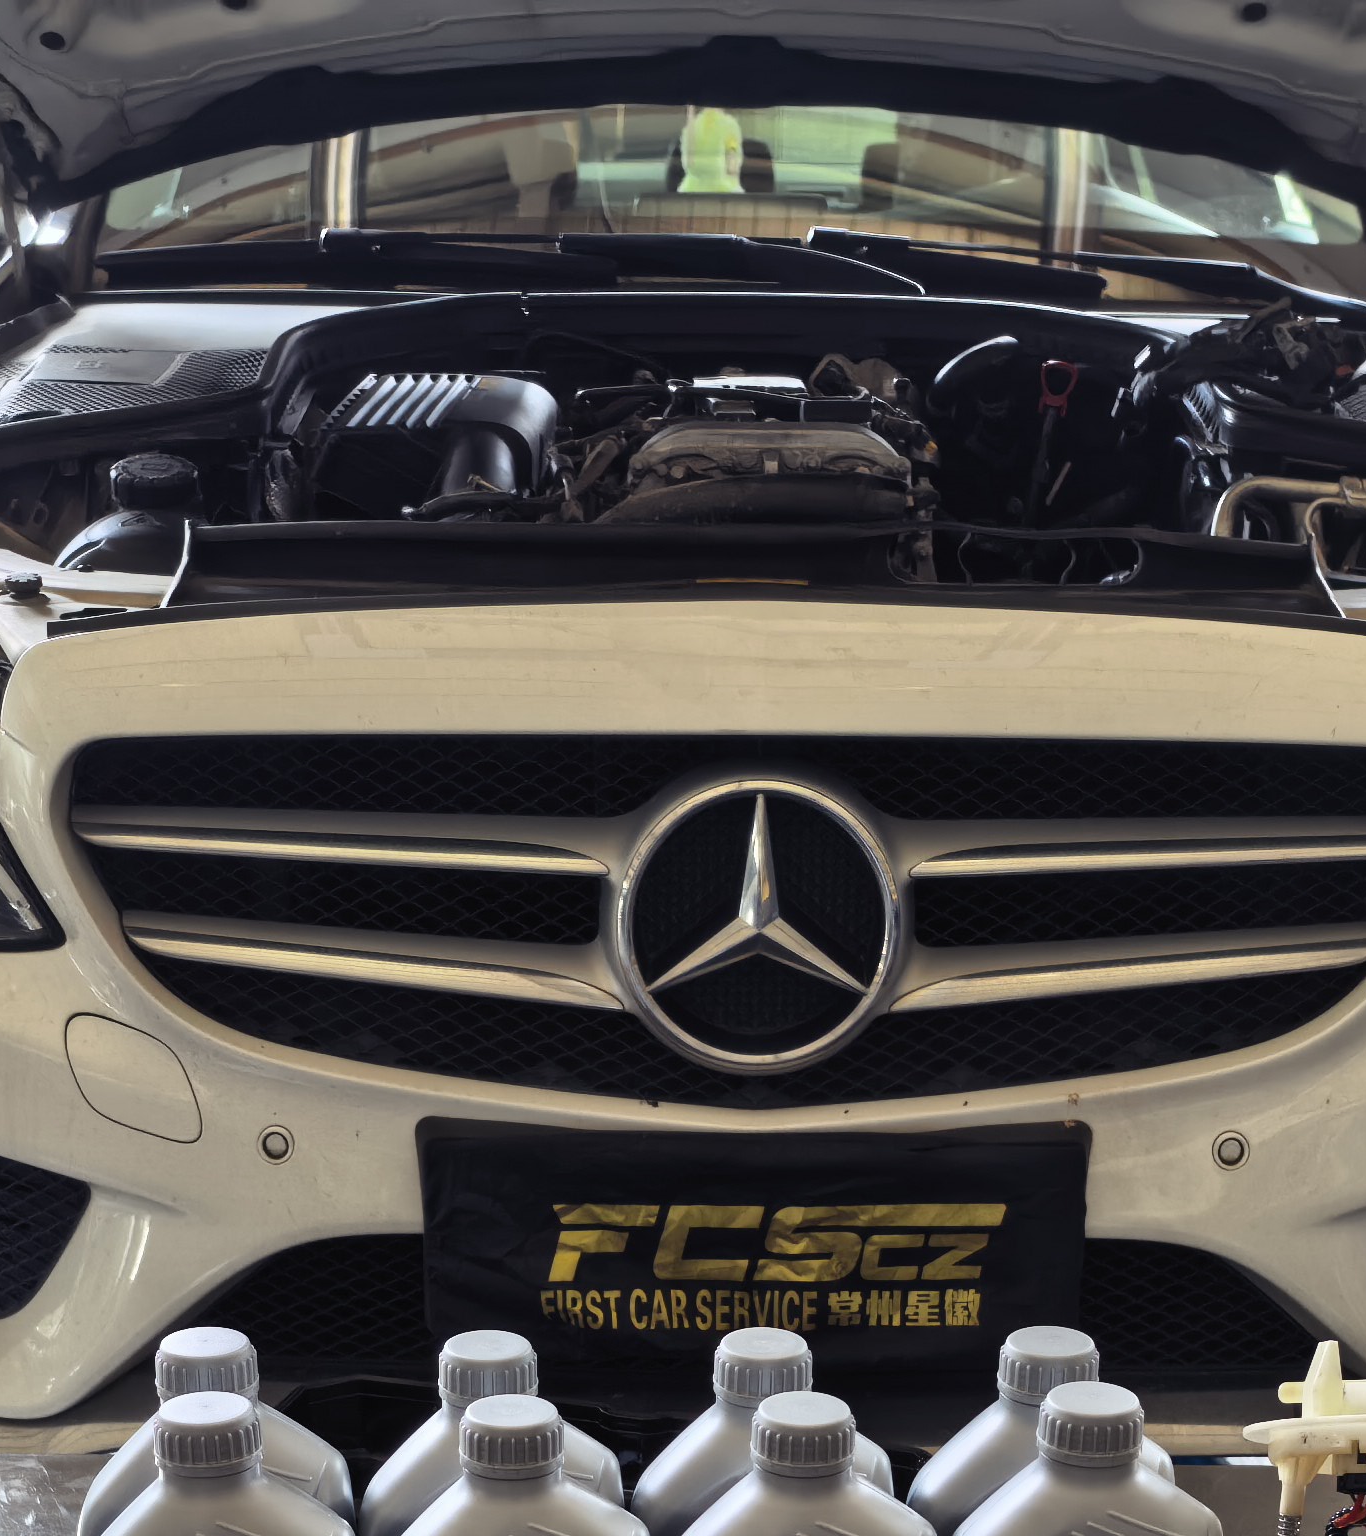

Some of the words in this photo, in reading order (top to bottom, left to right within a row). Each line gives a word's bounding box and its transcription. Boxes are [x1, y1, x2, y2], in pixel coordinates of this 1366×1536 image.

[540, 1289, 620, 1331] FIRST
[630, 1288, 690, 1331] CAR
[695, 1288, 818, 1331] SERVICE
[828, 1289, 982, 1328] 常州星徽
